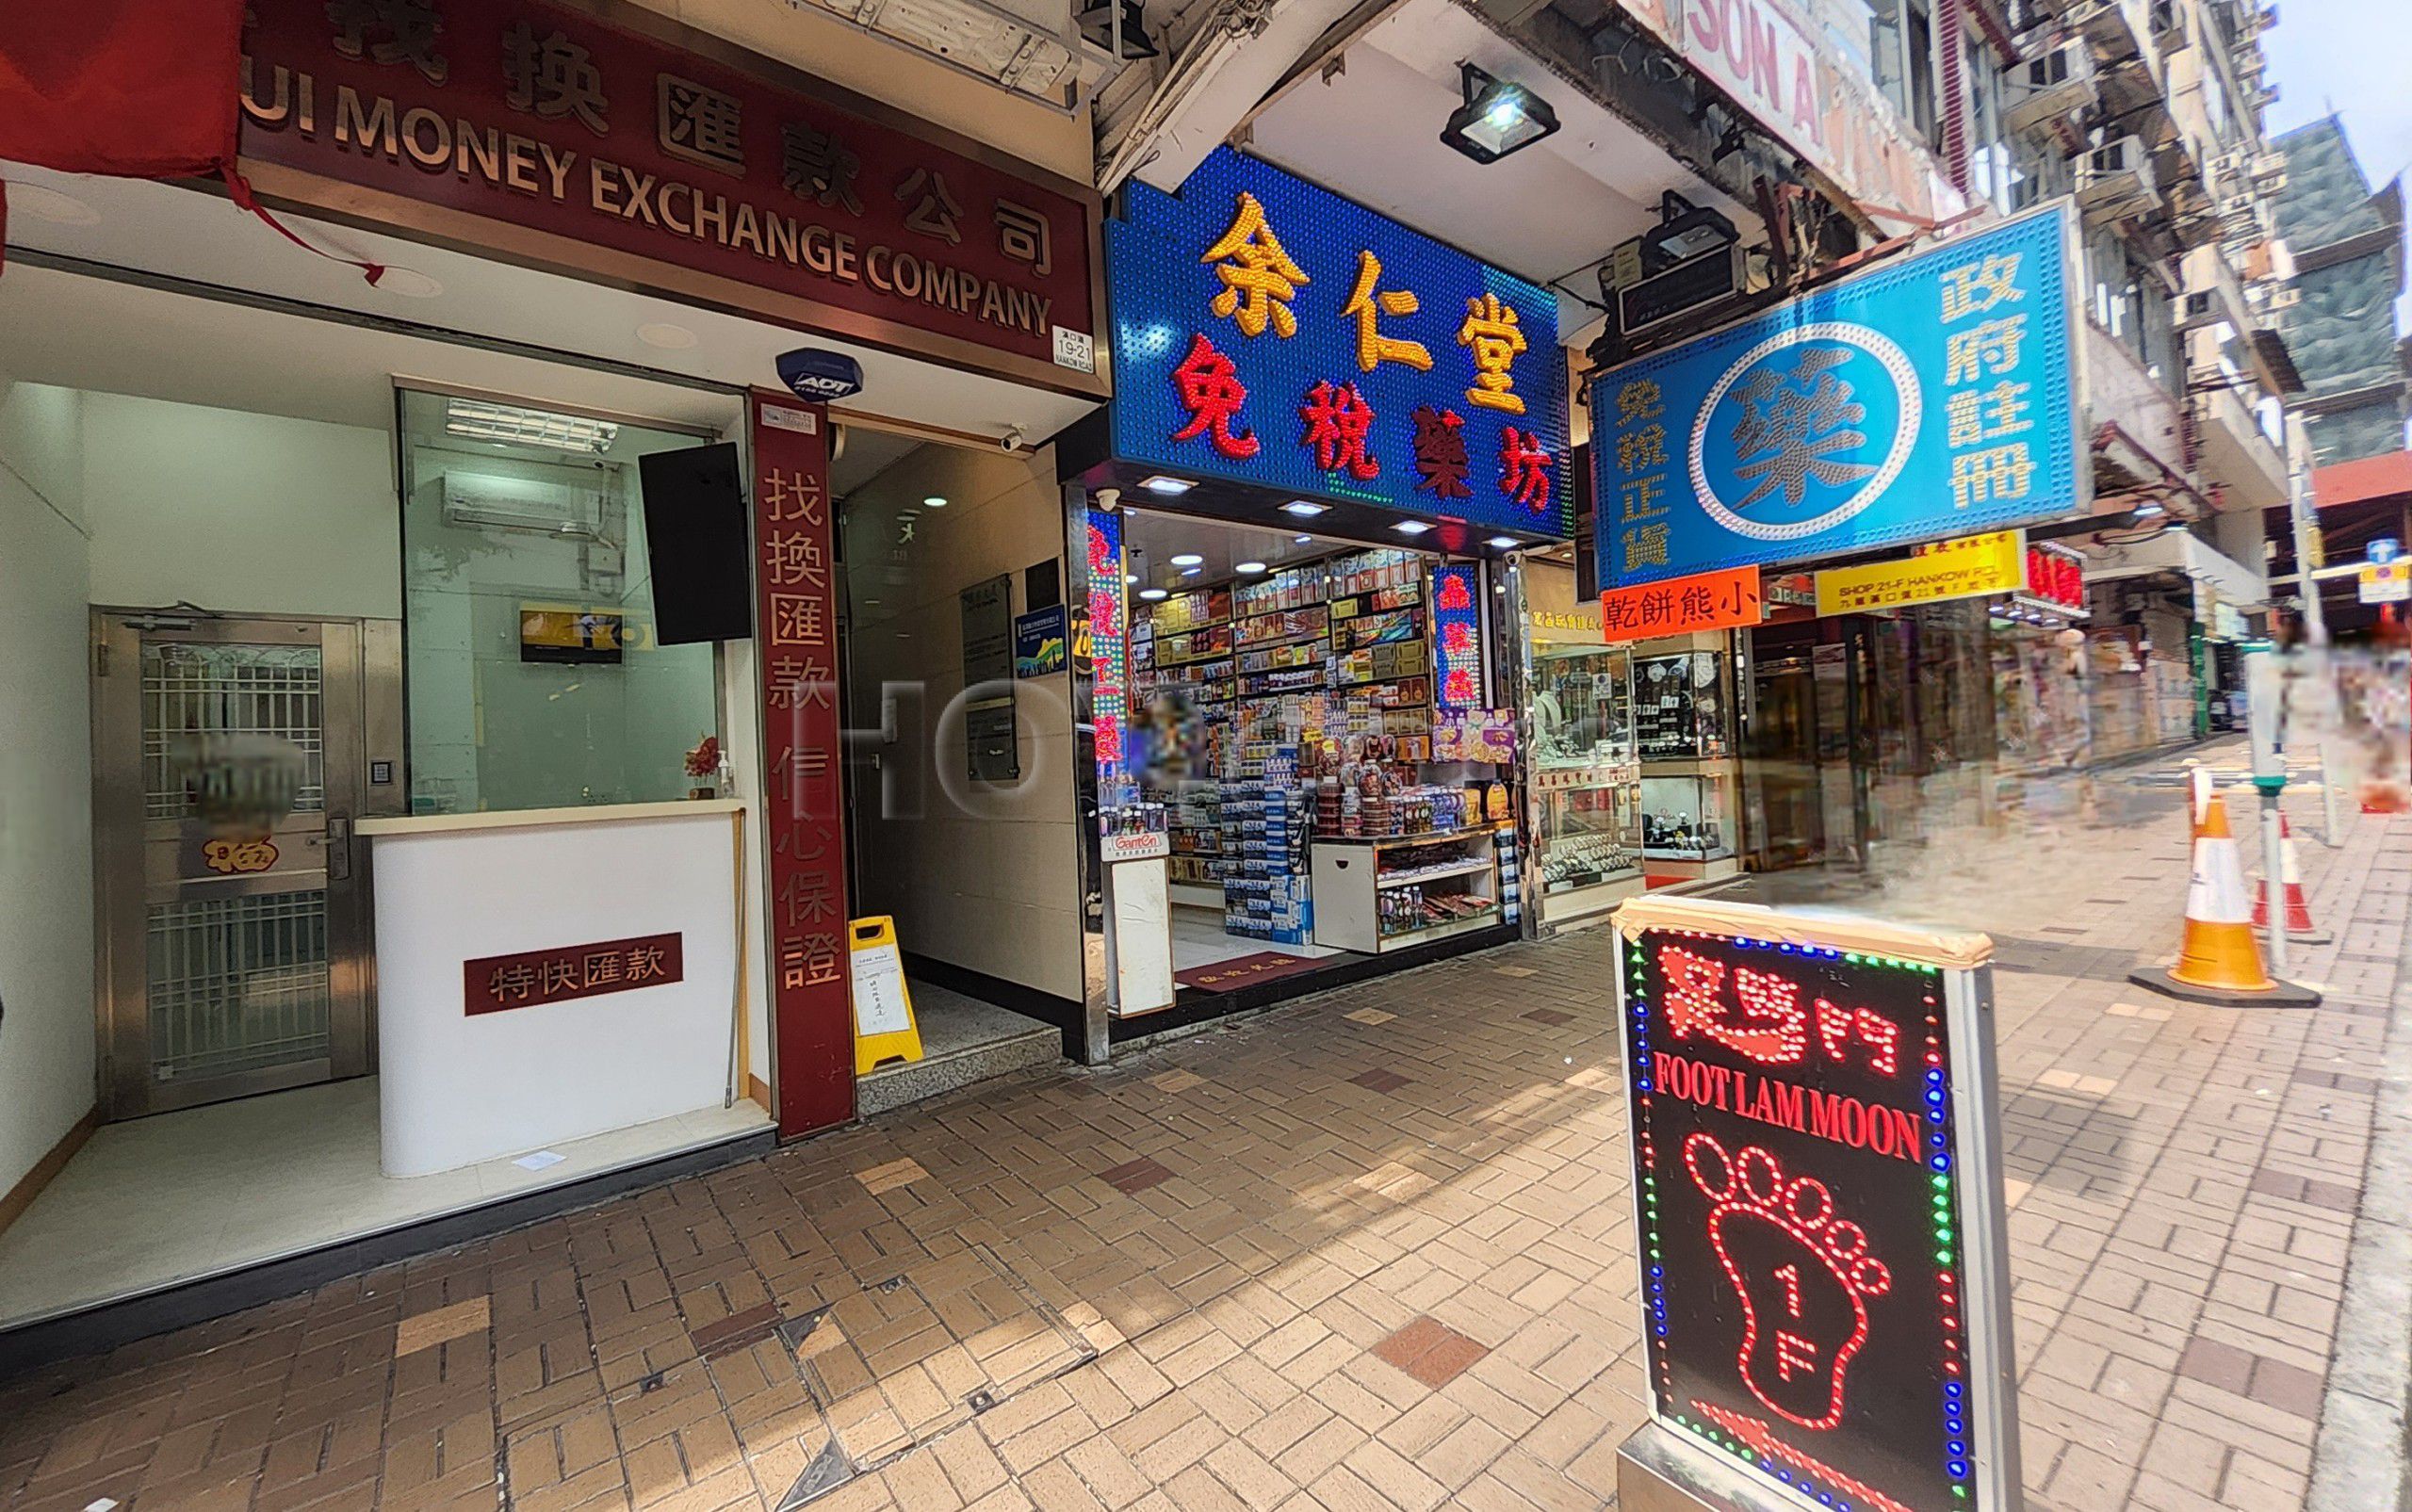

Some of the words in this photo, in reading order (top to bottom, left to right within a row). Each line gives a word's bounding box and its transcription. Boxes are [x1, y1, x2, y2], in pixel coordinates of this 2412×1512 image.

[242, 0, 1053, 279] 找換匯款公司
[334, 85, 578, 203] MONEY
[591, 161, 859, 282] EXCHANGE
[866, 244, 1053, 337] COMPANY
[796, 375, 854, 394] ADT
[1058, 339, 1091, 362] 19-21
[1200, 190, 1527, 415] 余仁堂
[1938, 251, 2035, 510] 政府註冊
[1171, 333, 1554, 514] 免稅藥坊
[762, 466, 833, 712] 找換匯款
[1839, 582, 1875, 598] SHOP
[1907, 568, 1969, 589] HANKOW
[771, 743, 844, 991] 信心保證
[488, 945, 667, 1002] 特快匯款
[1653, 1051, 1732, 1113] FOOT
[1734, 1067, 1807, 1133] LAM
[1809, 1087, 1923, 1164] MOON
